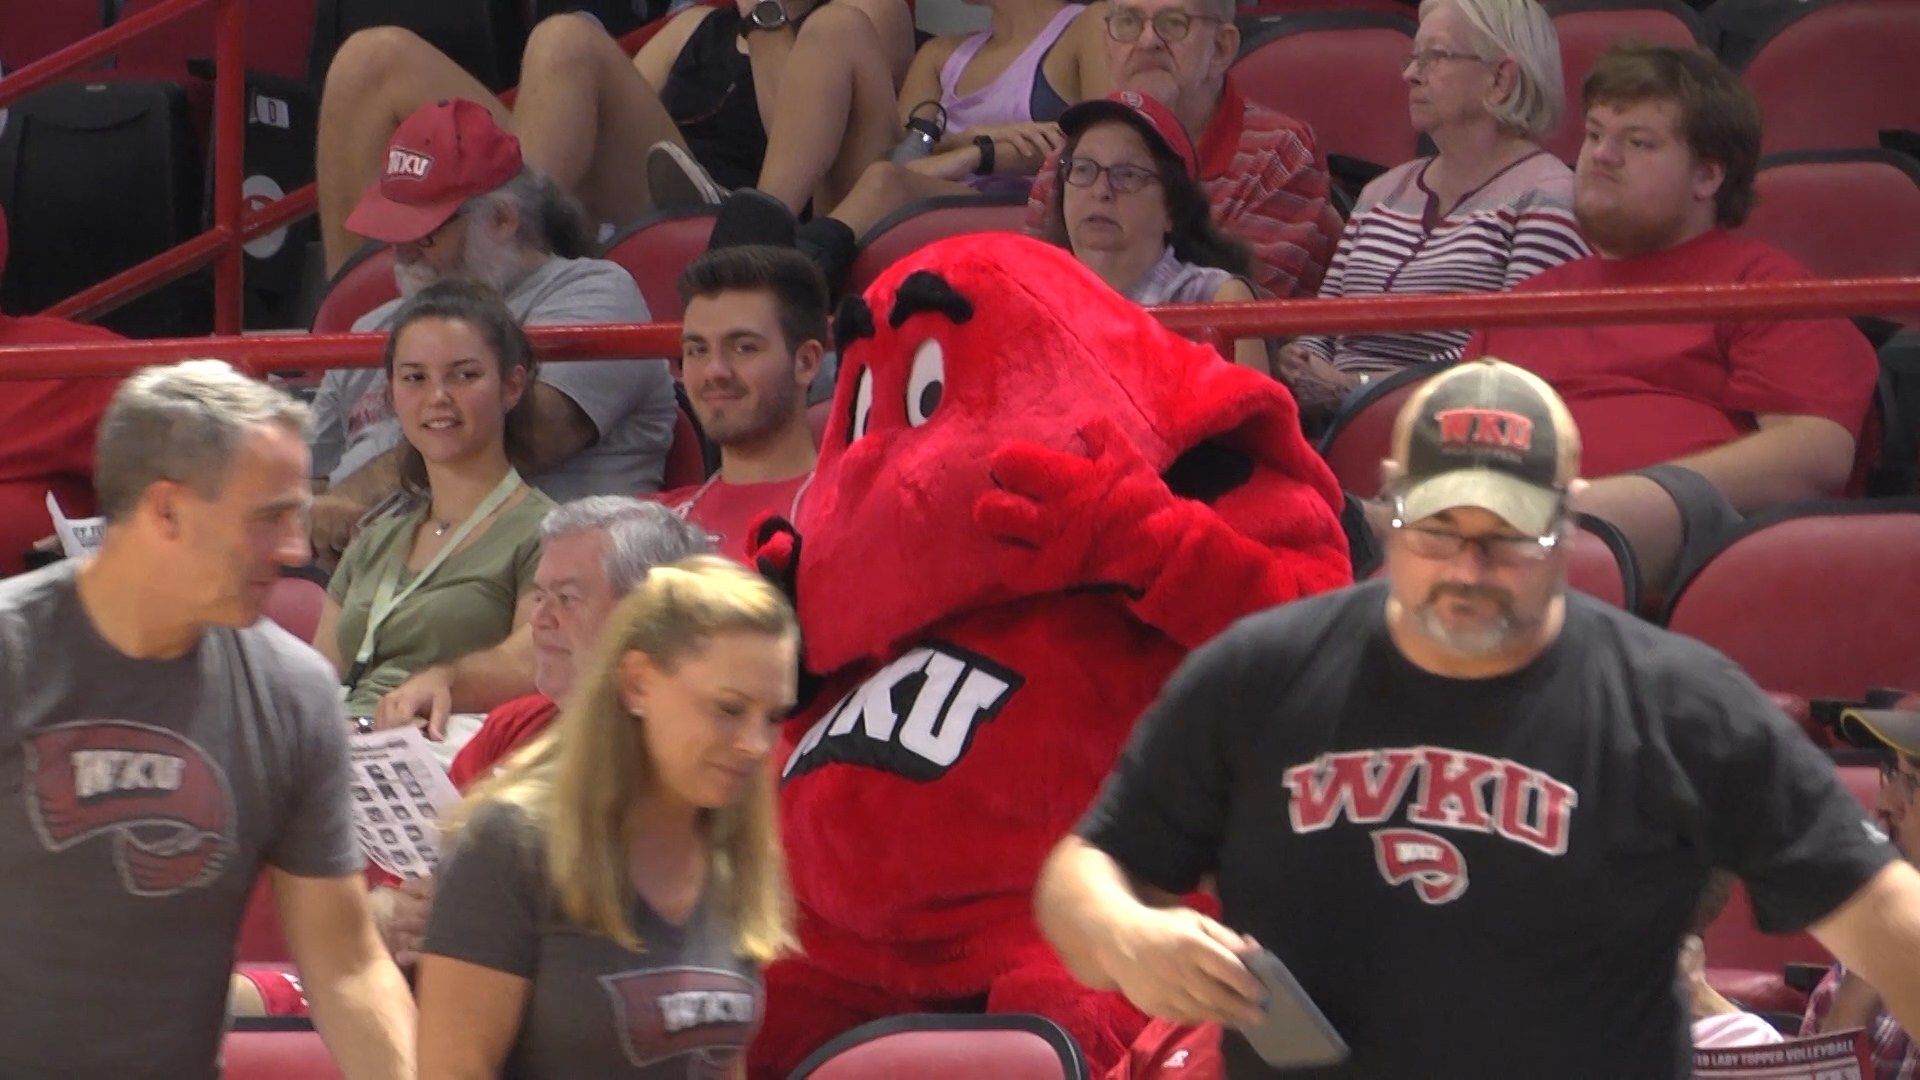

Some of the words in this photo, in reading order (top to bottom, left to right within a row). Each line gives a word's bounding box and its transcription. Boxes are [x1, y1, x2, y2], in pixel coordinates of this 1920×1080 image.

[1434, 408, 1533, 450] WKU
[71, 750, 187, 798] WKU
[1282, 745, 1578, 856] WKU
[1711, 1052, 1739, 1067] LADY
[1785, 1039, 1854, 1062] VOLLEYBALL
